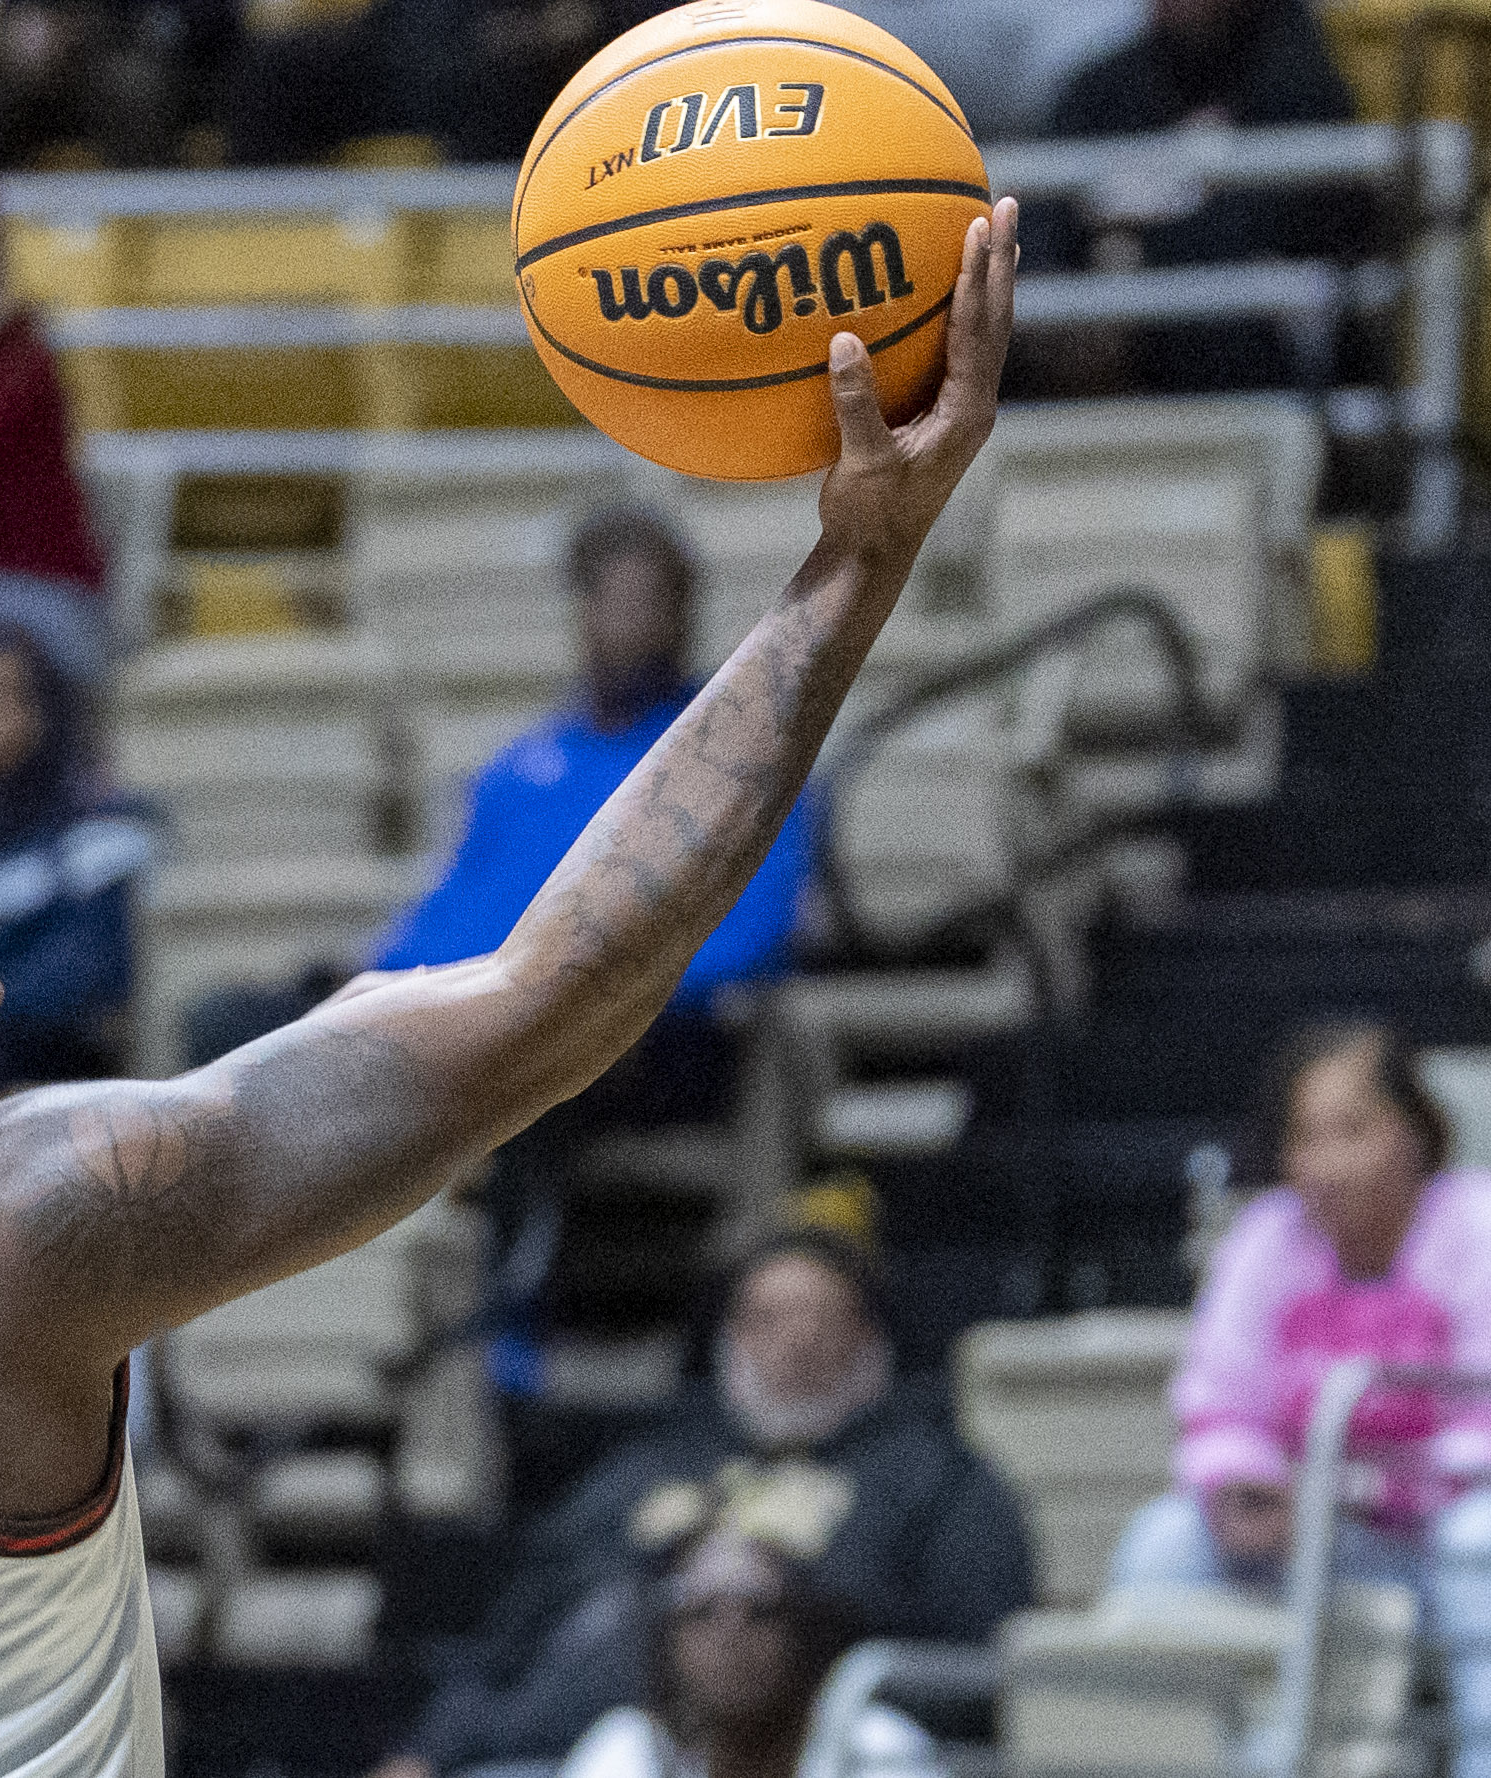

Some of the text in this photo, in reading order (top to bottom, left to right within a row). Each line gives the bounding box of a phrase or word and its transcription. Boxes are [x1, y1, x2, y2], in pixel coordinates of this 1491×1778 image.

[584, 83, 825, 191] EVO NXT
[591, 222, 914, 335] Wilson
